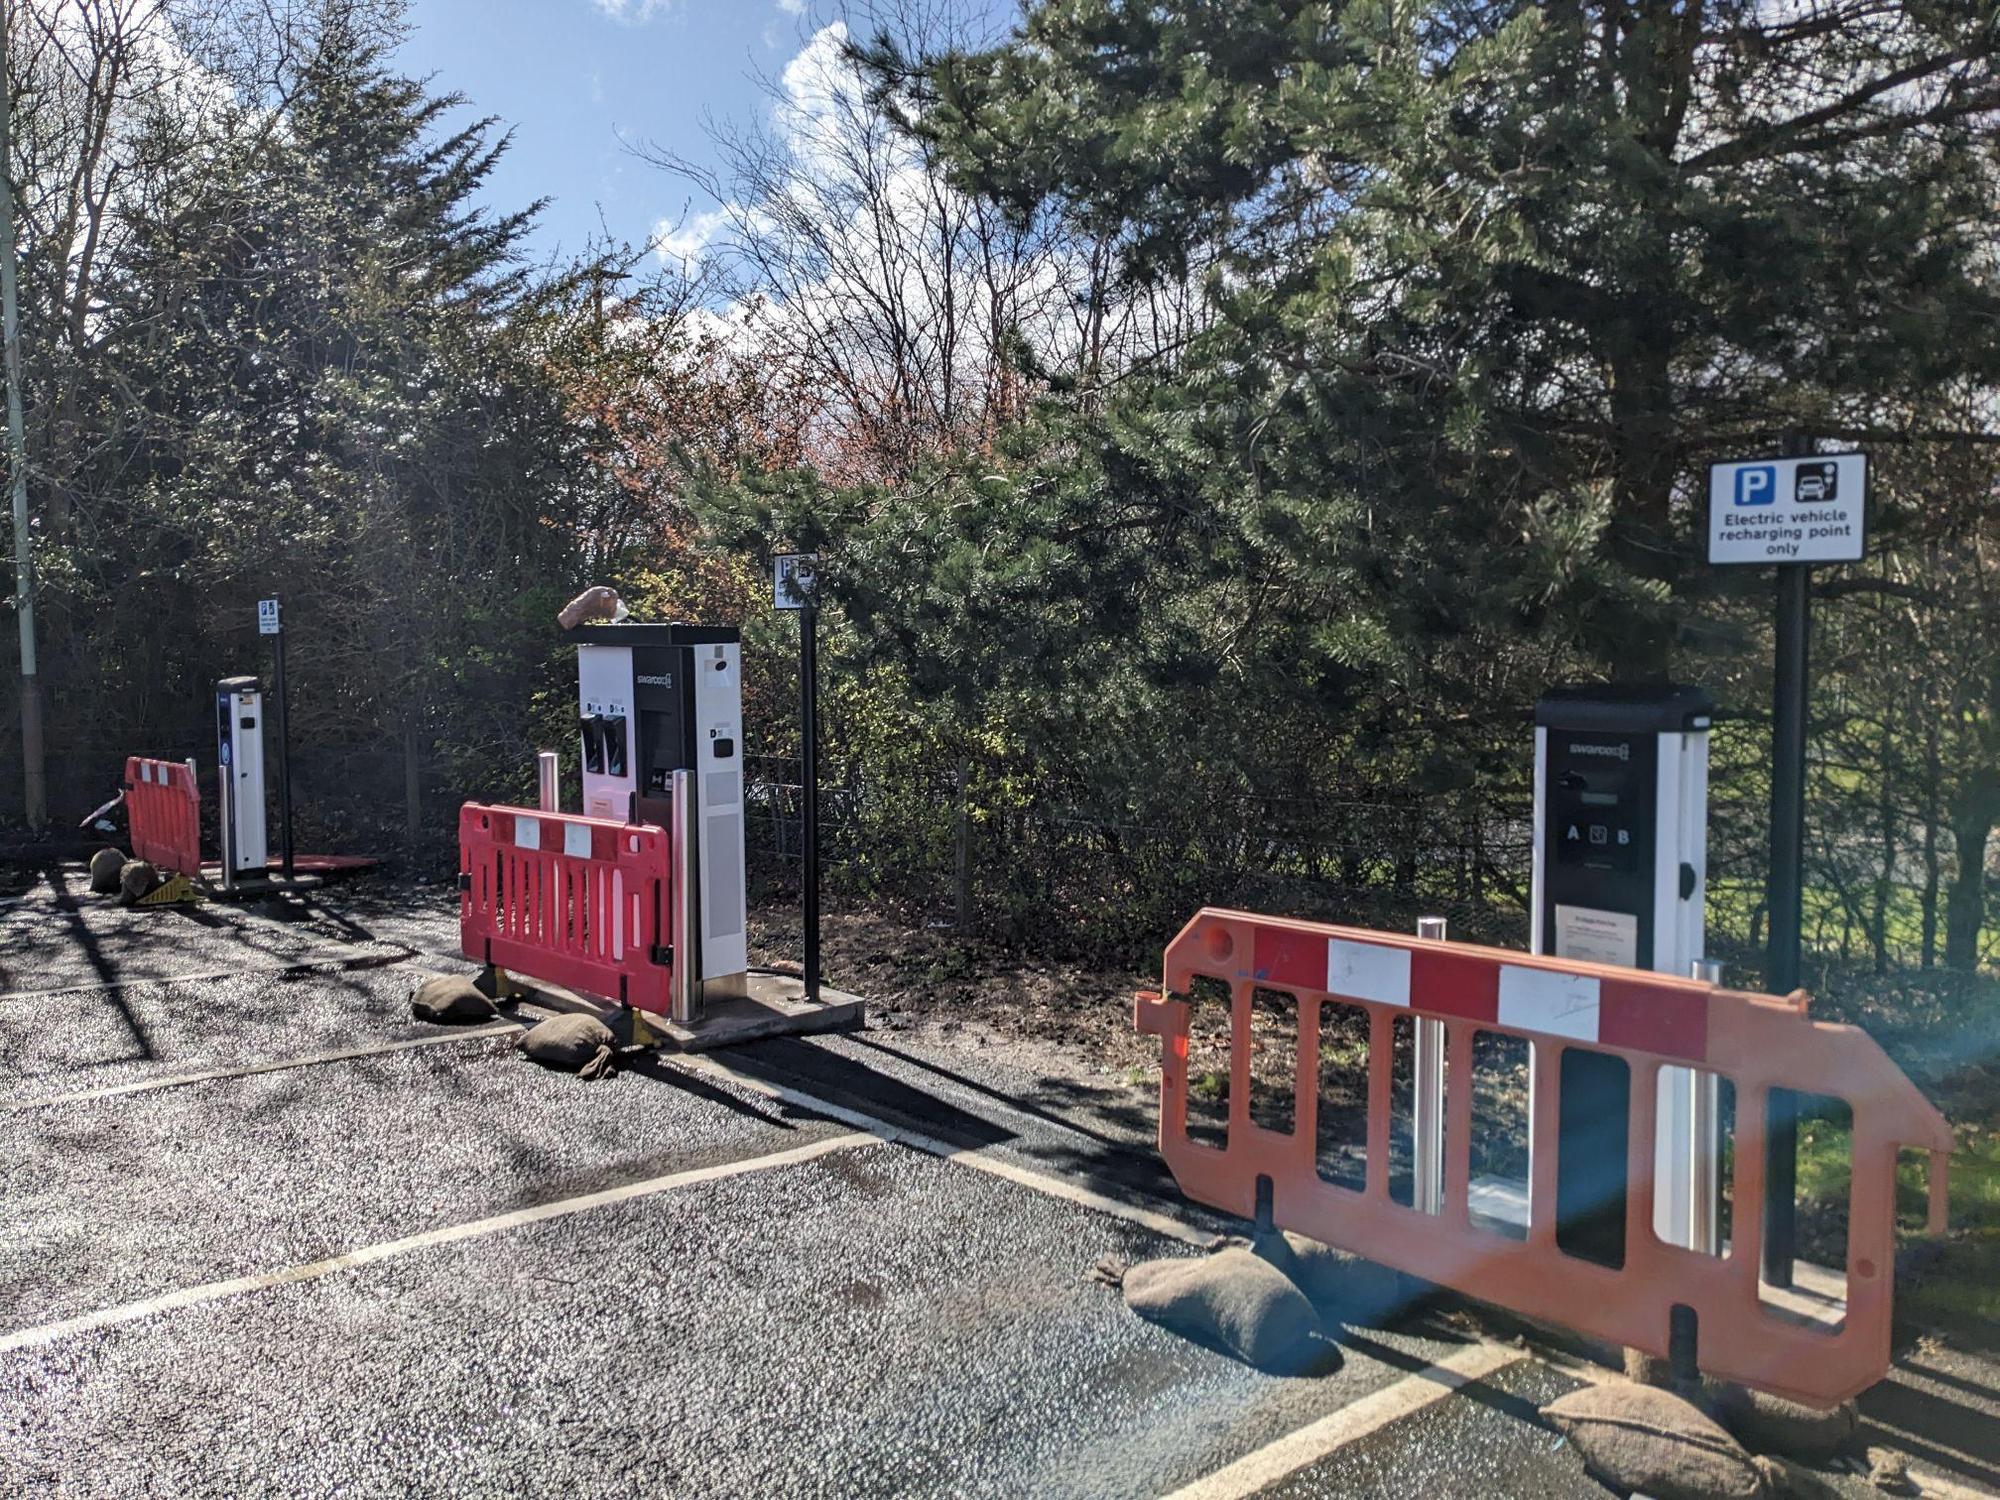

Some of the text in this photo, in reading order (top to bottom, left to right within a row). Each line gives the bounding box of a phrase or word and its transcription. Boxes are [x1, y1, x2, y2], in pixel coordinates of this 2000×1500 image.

[1741, 470, 1768, 502] P
[1724, 509, 1847, 527] Electric vehicle
[1719, 524, 1851, 542] recharging point
[1766, 542, 1800, 556] only
[1567, 824, 1579, 840] A
[1617, 829, 1630, 845] B
